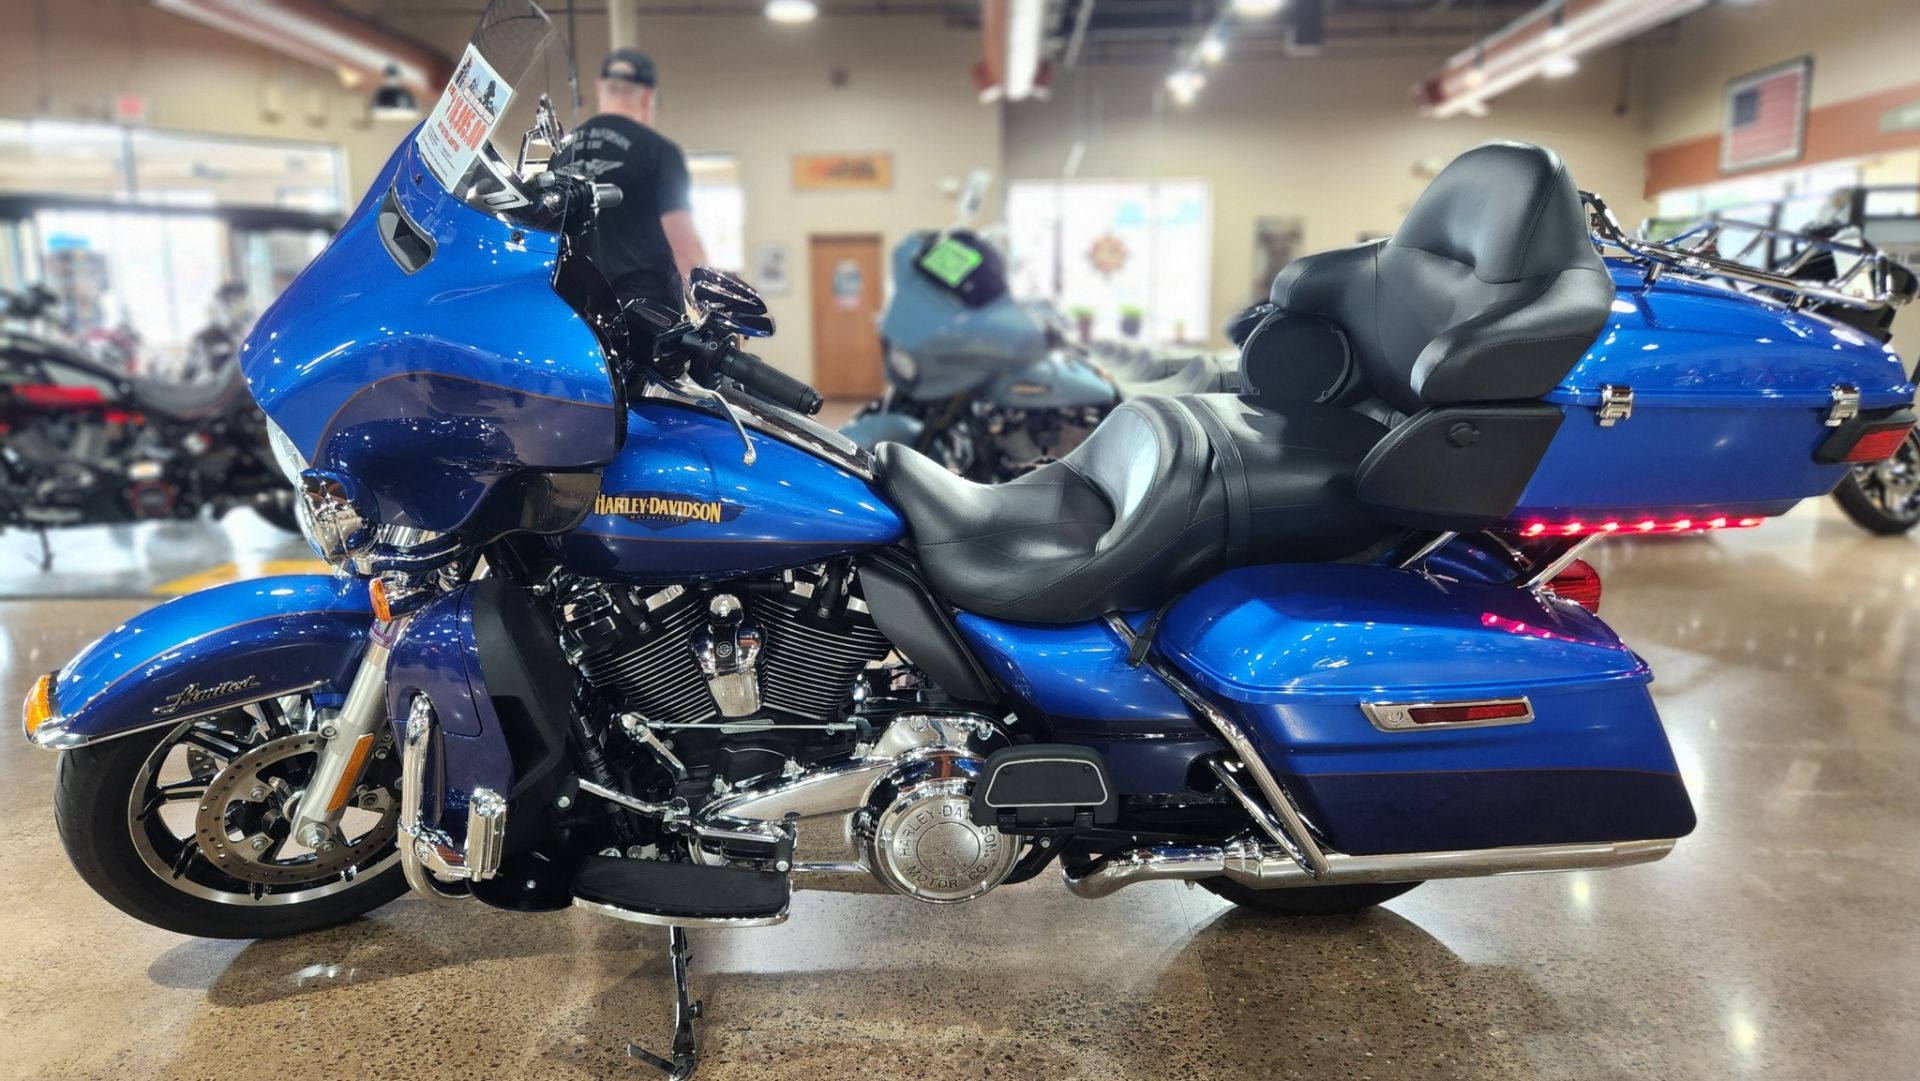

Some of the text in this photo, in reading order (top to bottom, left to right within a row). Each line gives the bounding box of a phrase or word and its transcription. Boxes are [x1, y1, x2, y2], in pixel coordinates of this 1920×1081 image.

[594, 493, 722, 524] HARLEY-DAVIDSON
[152, 674, 261, 715] Limited
[899, 804, 997, 858] HARLEY-DASON
[906, 865, 959, 889] MOTOR
